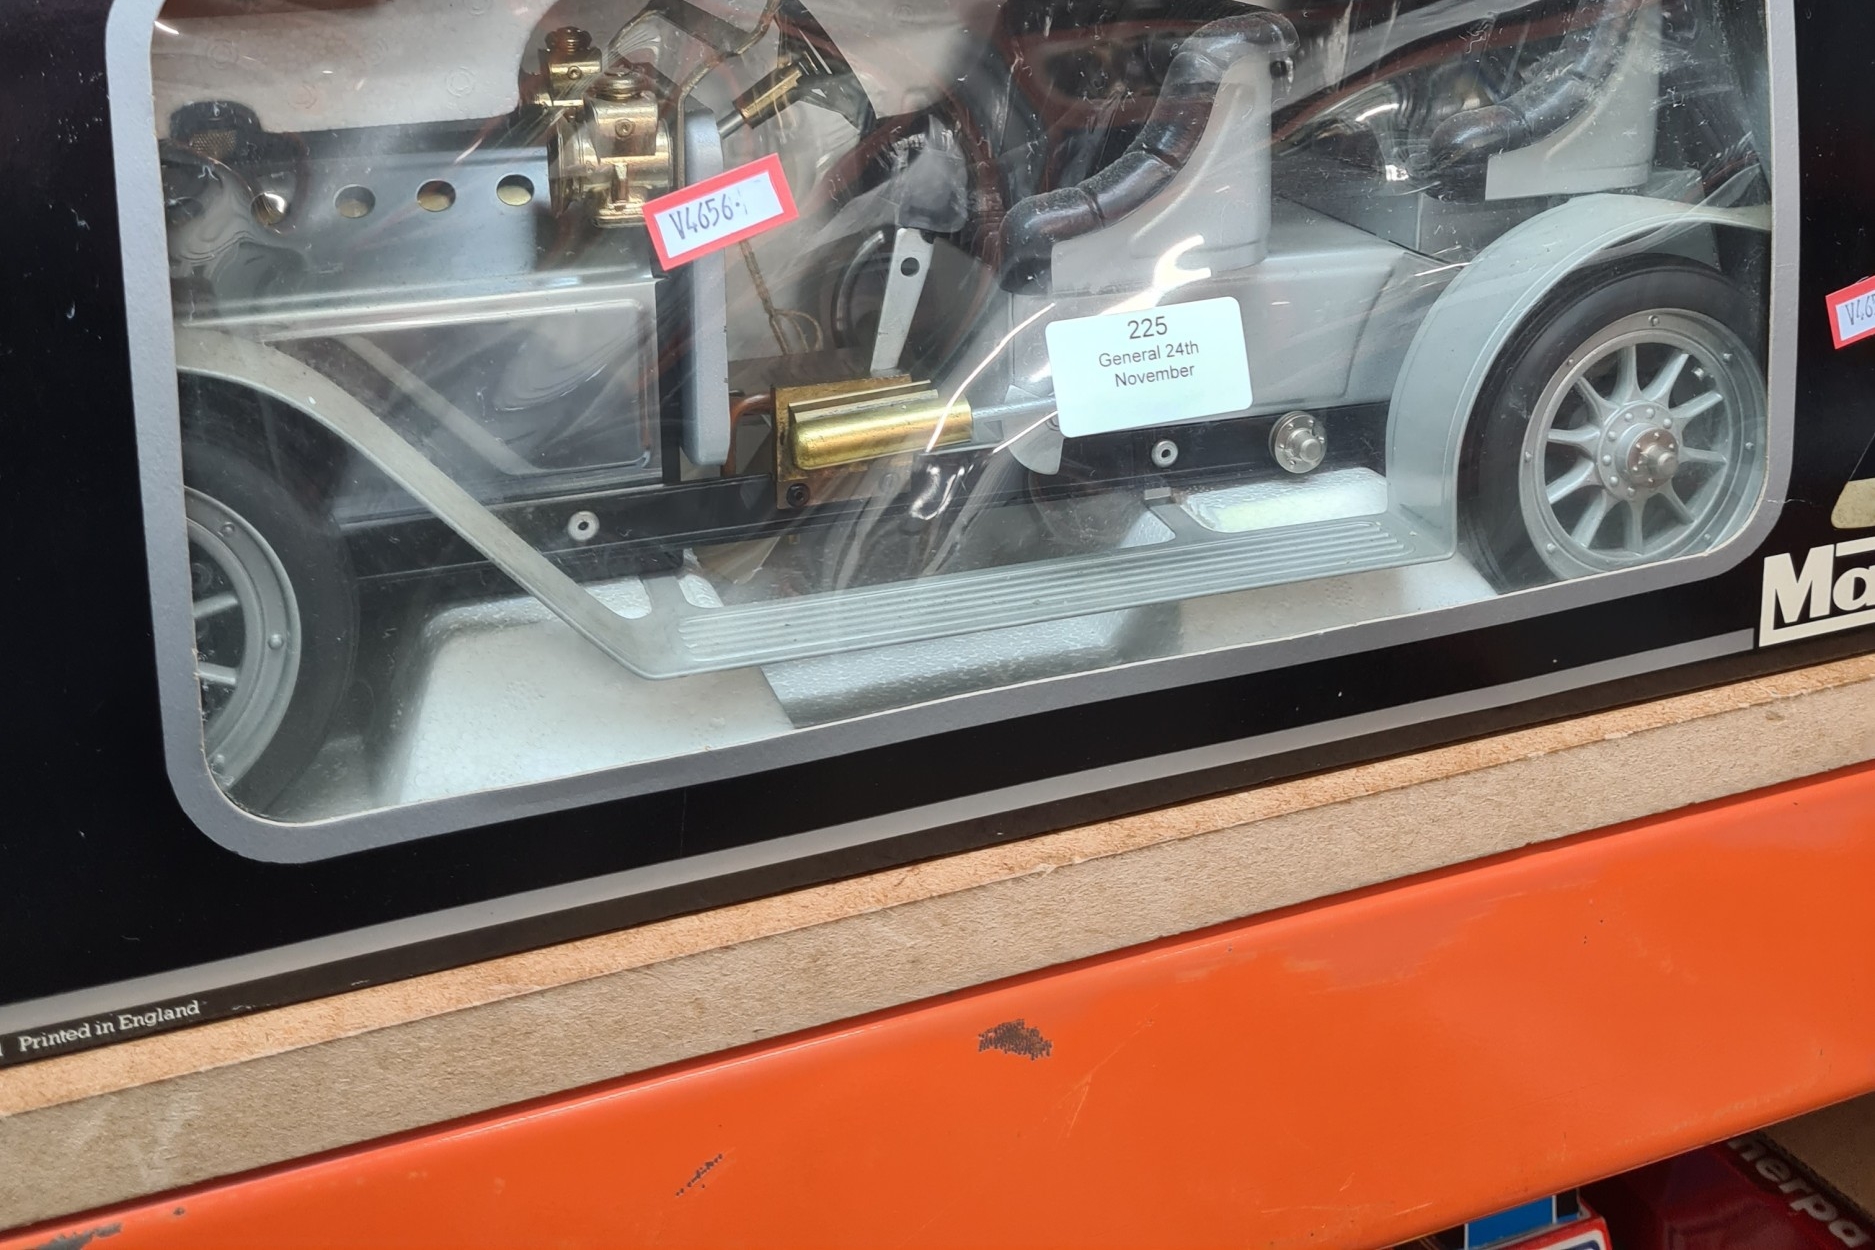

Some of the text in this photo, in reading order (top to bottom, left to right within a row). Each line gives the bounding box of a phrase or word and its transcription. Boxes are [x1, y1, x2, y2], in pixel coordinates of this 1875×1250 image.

[1127, 315, 1168, 340] 225
[1098, 340, 1200, 368] General 24th
[1114, 365, 1195, 388] November
[18, 1023, 92, 1052] Printed
[95, 1020, 116, 1036] in
[118, 1000, 200, 1032] England
